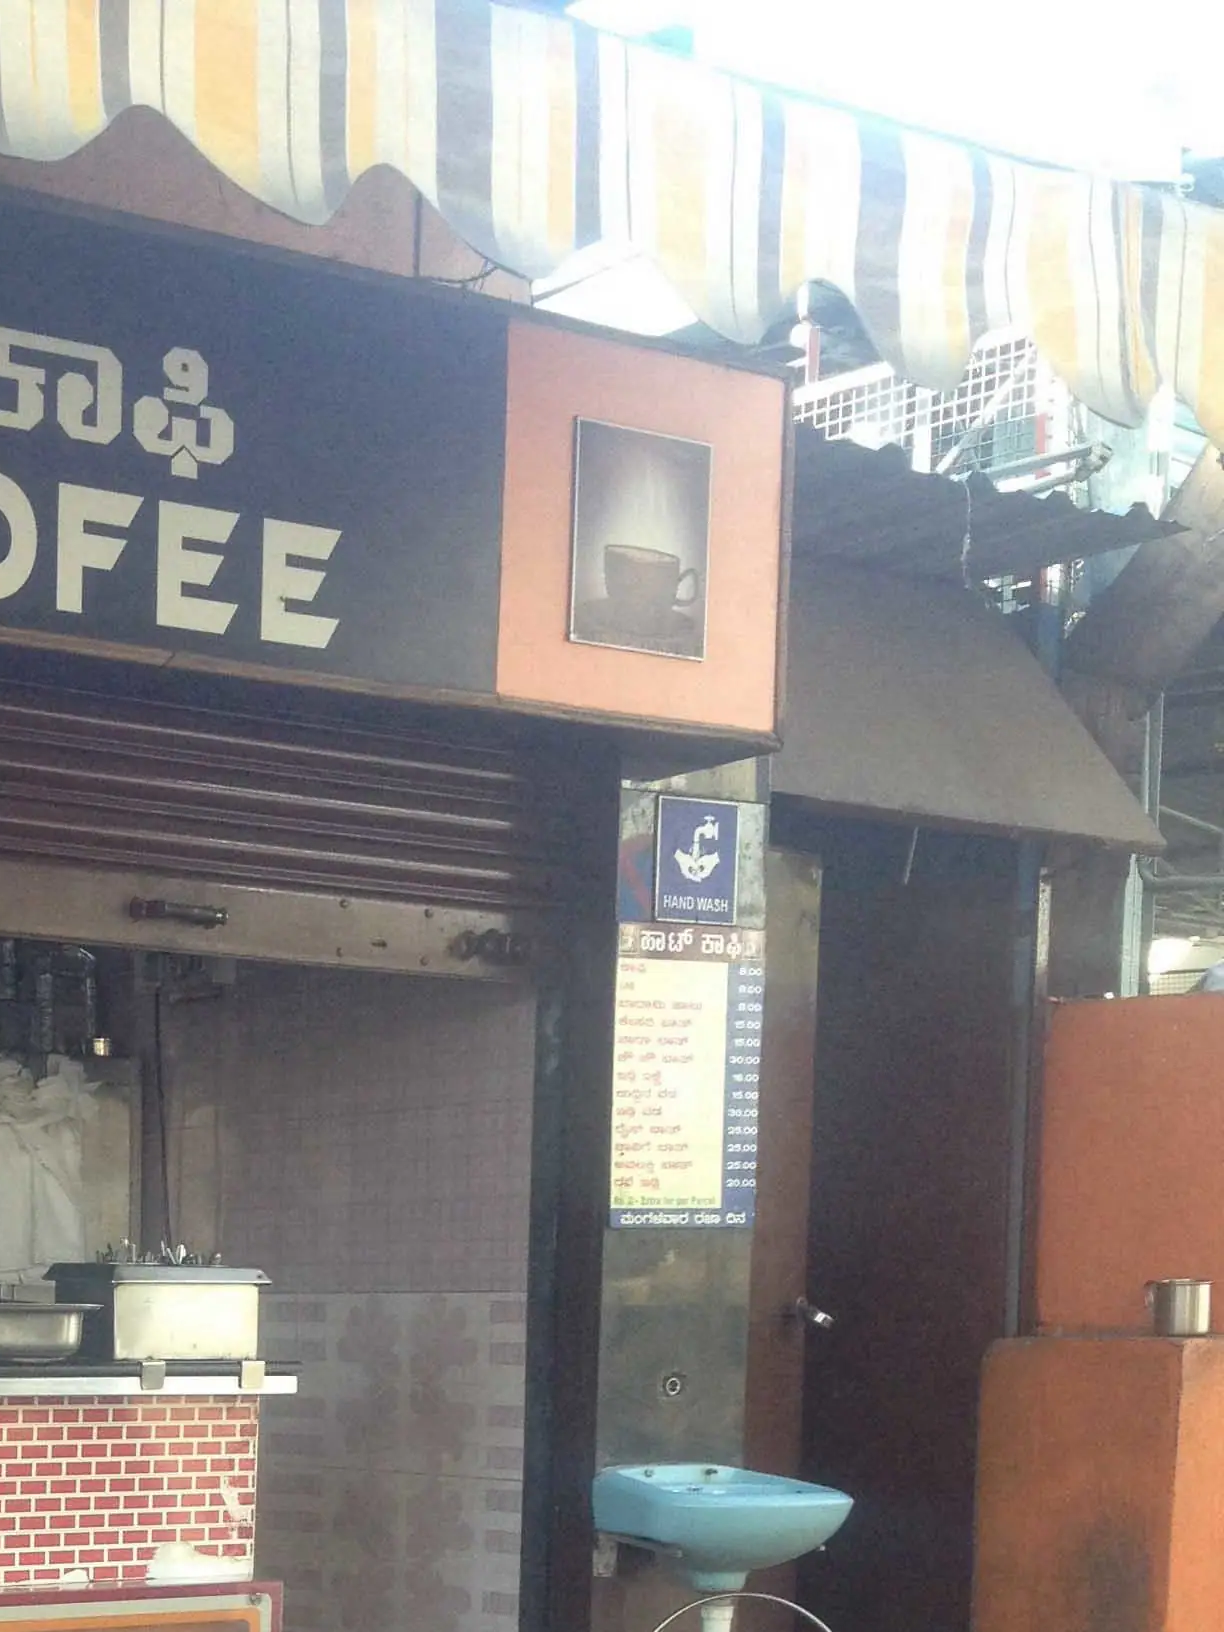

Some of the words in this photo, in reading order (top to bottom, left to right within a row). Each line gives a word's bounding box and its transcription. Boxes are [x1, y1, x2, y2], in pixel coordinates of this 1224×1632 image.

[663, 895, 694, 911] HAND
[695, 897, 728, 913] WASH
[640, 929, 694, 952] ಹಾಟ್
[701, 933, 741, 959] ಕಾಫಿ
